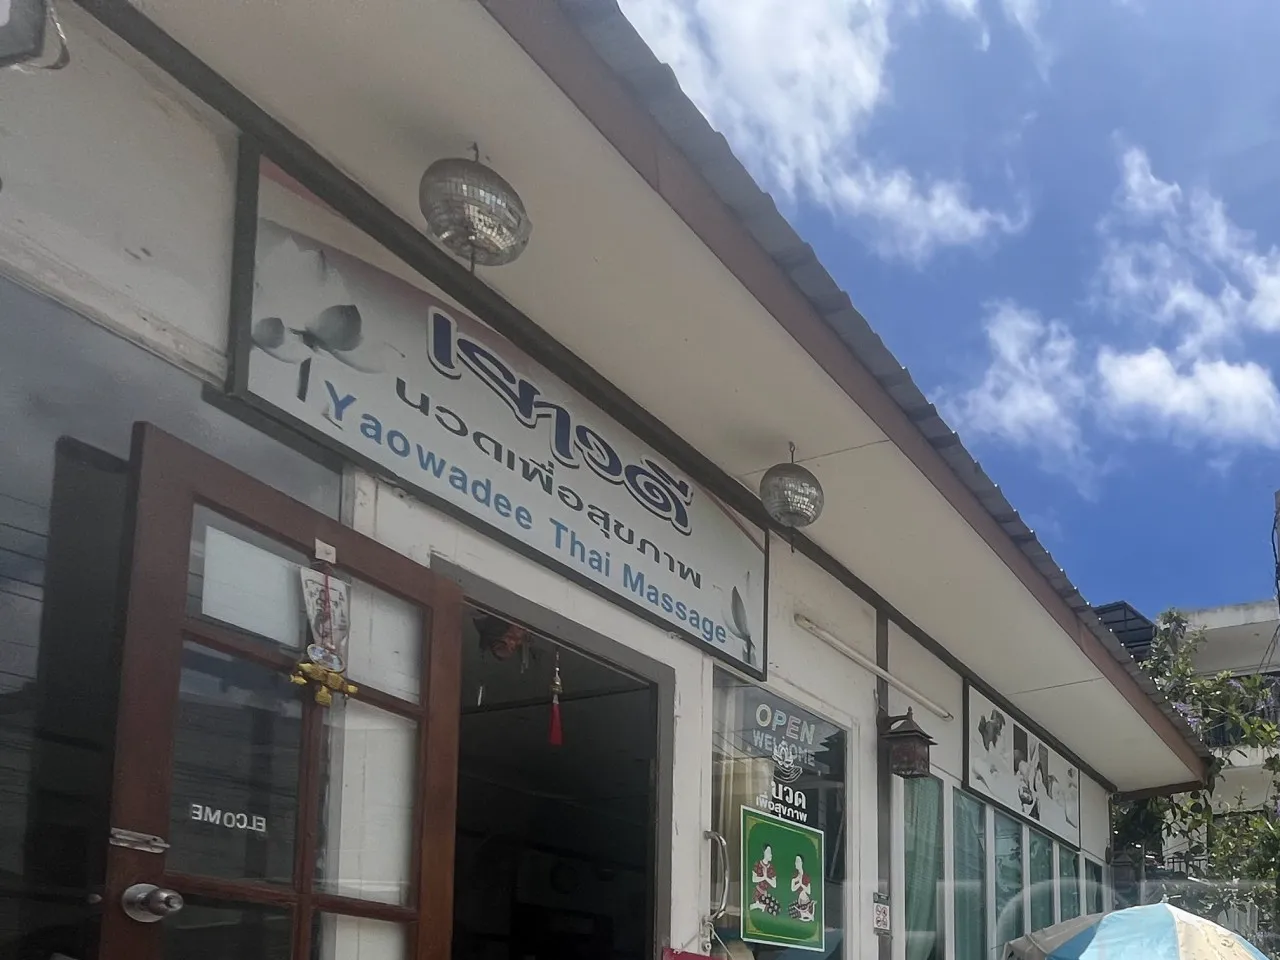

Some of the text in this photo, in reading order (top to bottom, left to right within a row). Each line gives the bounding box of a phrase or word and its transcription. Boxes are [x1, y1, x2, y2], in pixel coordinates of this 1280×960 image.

[324, 379, 727, 643] Yaowadee Thai Massage
[396, 377, 701, 589] นวดเพื่อสุขภาพ
[755, 703, 815, 745] OPEN
[771, 780, 806, 810] นวด
